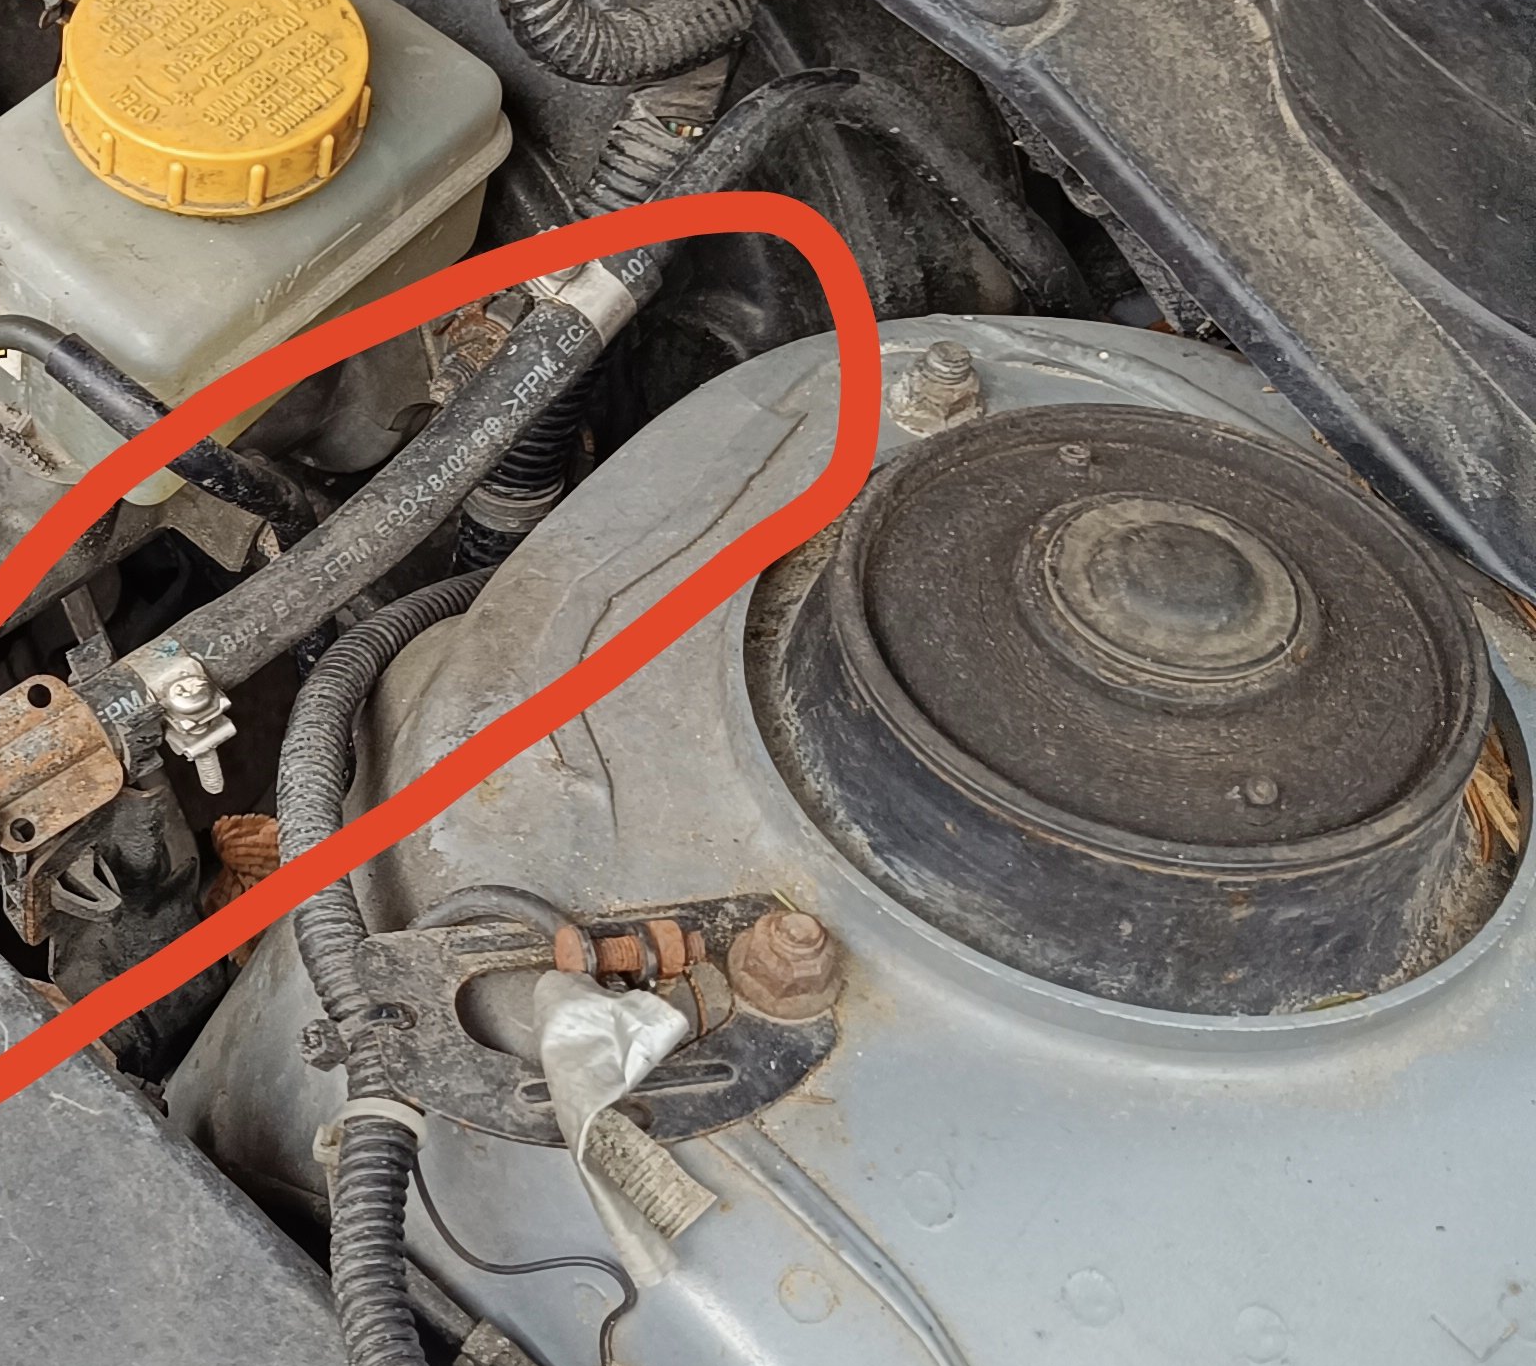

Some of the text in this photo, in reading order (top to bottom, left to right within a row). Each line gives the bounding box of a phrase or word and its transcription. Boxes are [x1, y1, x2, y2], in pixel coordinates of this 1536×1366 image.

[154, 15, 198, 55] ONLY
[268, 27, 327, 79] BEFORE
[295, 42, 346, 89] CLEAN
[111, 85, 161, 123] OPEN
[198, 65, 276, 130] REMOVING
[251, 74, 304, 122] FILLER
[263, 76, 341, 141] WARNING
[224, 109, 258, 143] CAP
